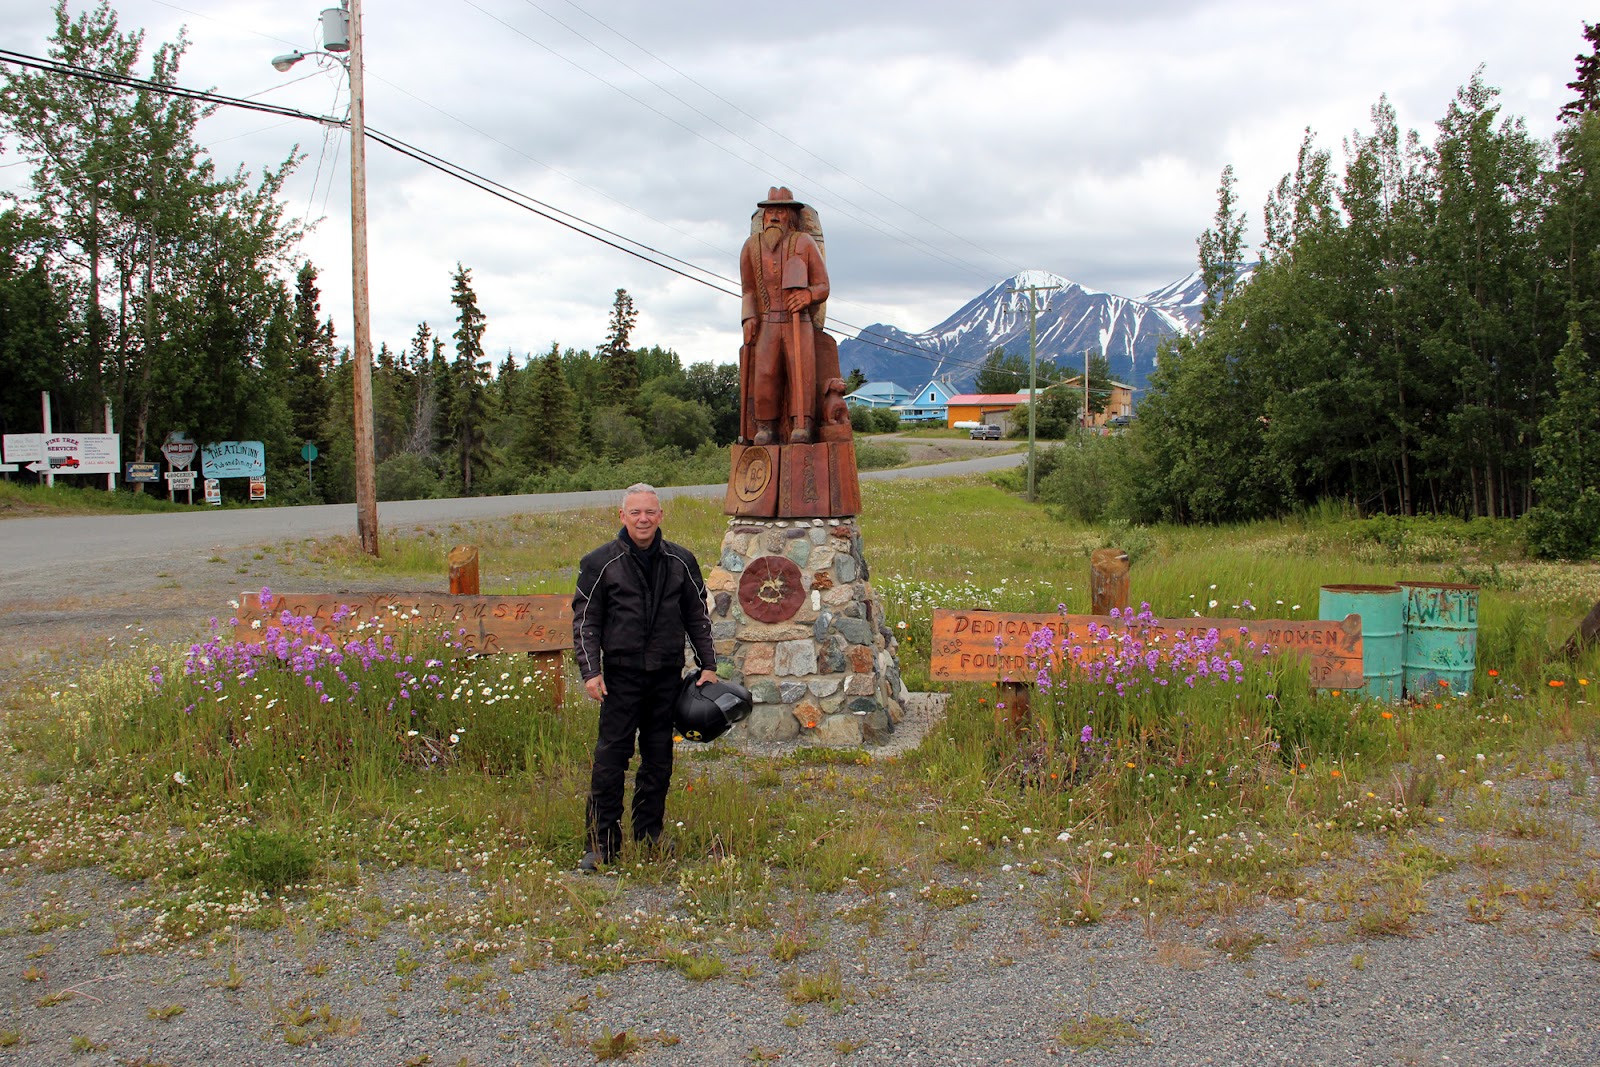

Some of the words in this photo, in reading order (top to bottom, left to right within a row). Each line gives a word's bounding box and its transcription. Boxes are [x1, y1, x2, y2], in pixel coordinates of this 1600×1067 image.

[45, 437, 61, 446] PINE
[62, 437, 80, 446] TREE
[210, 447, 223, 459] THE
[224, 444, 247, 456] ATLIN
[247, 447, 260, 459] INN
[1266, 629, 1338, 645] WOMEN
[937, 638, 963, 657] 1898
